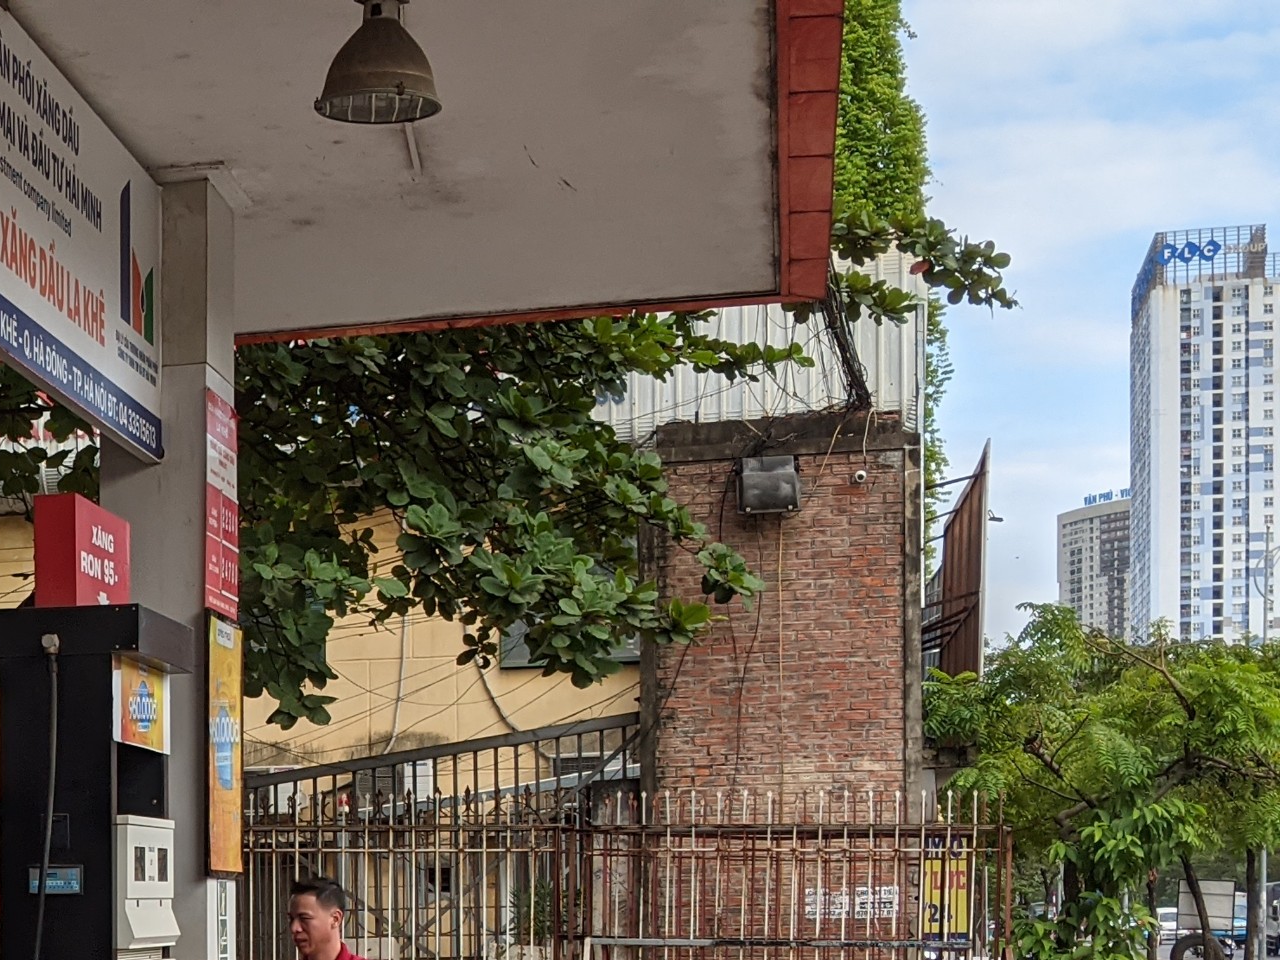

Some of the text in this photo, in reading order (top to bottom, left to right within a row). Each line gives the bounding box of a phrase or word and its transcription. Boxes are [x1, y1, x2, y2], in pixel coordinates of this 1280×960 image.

[12, 53, 34, 110] PHỐI
[36, 78, 60, 136] XĂNG
[61, 105, 79, 157] DẦU
[17, 114, 30, 161] VÀ
[31, 127, 50, 181] ĐẦU
[51, 151, 64, 194] TƯ
[80, 182, 102, 233] MINH
[23, 179, 51, 222] company
[51, 200, 71, 238] limited
[0, 204, 37, 290] XĂNG
[39, 238, 64, 313] DẦU
[66, 270, 81, 328] LA
[82, 285, 106, 348] KHÊ
[1164, 245, 1214, 259] FLC
[0, 310, 18, 348] KHÊ
[33, 335, 45, 369] HÀ
[46, 344, 67, 385] ĐÔNG
[84, 373, 94, 405] HÀ
[95, 381, 107, 418] NỘI
[80, 550, 101, 580] RON
[91, 525, 114, 553] XĂNG
